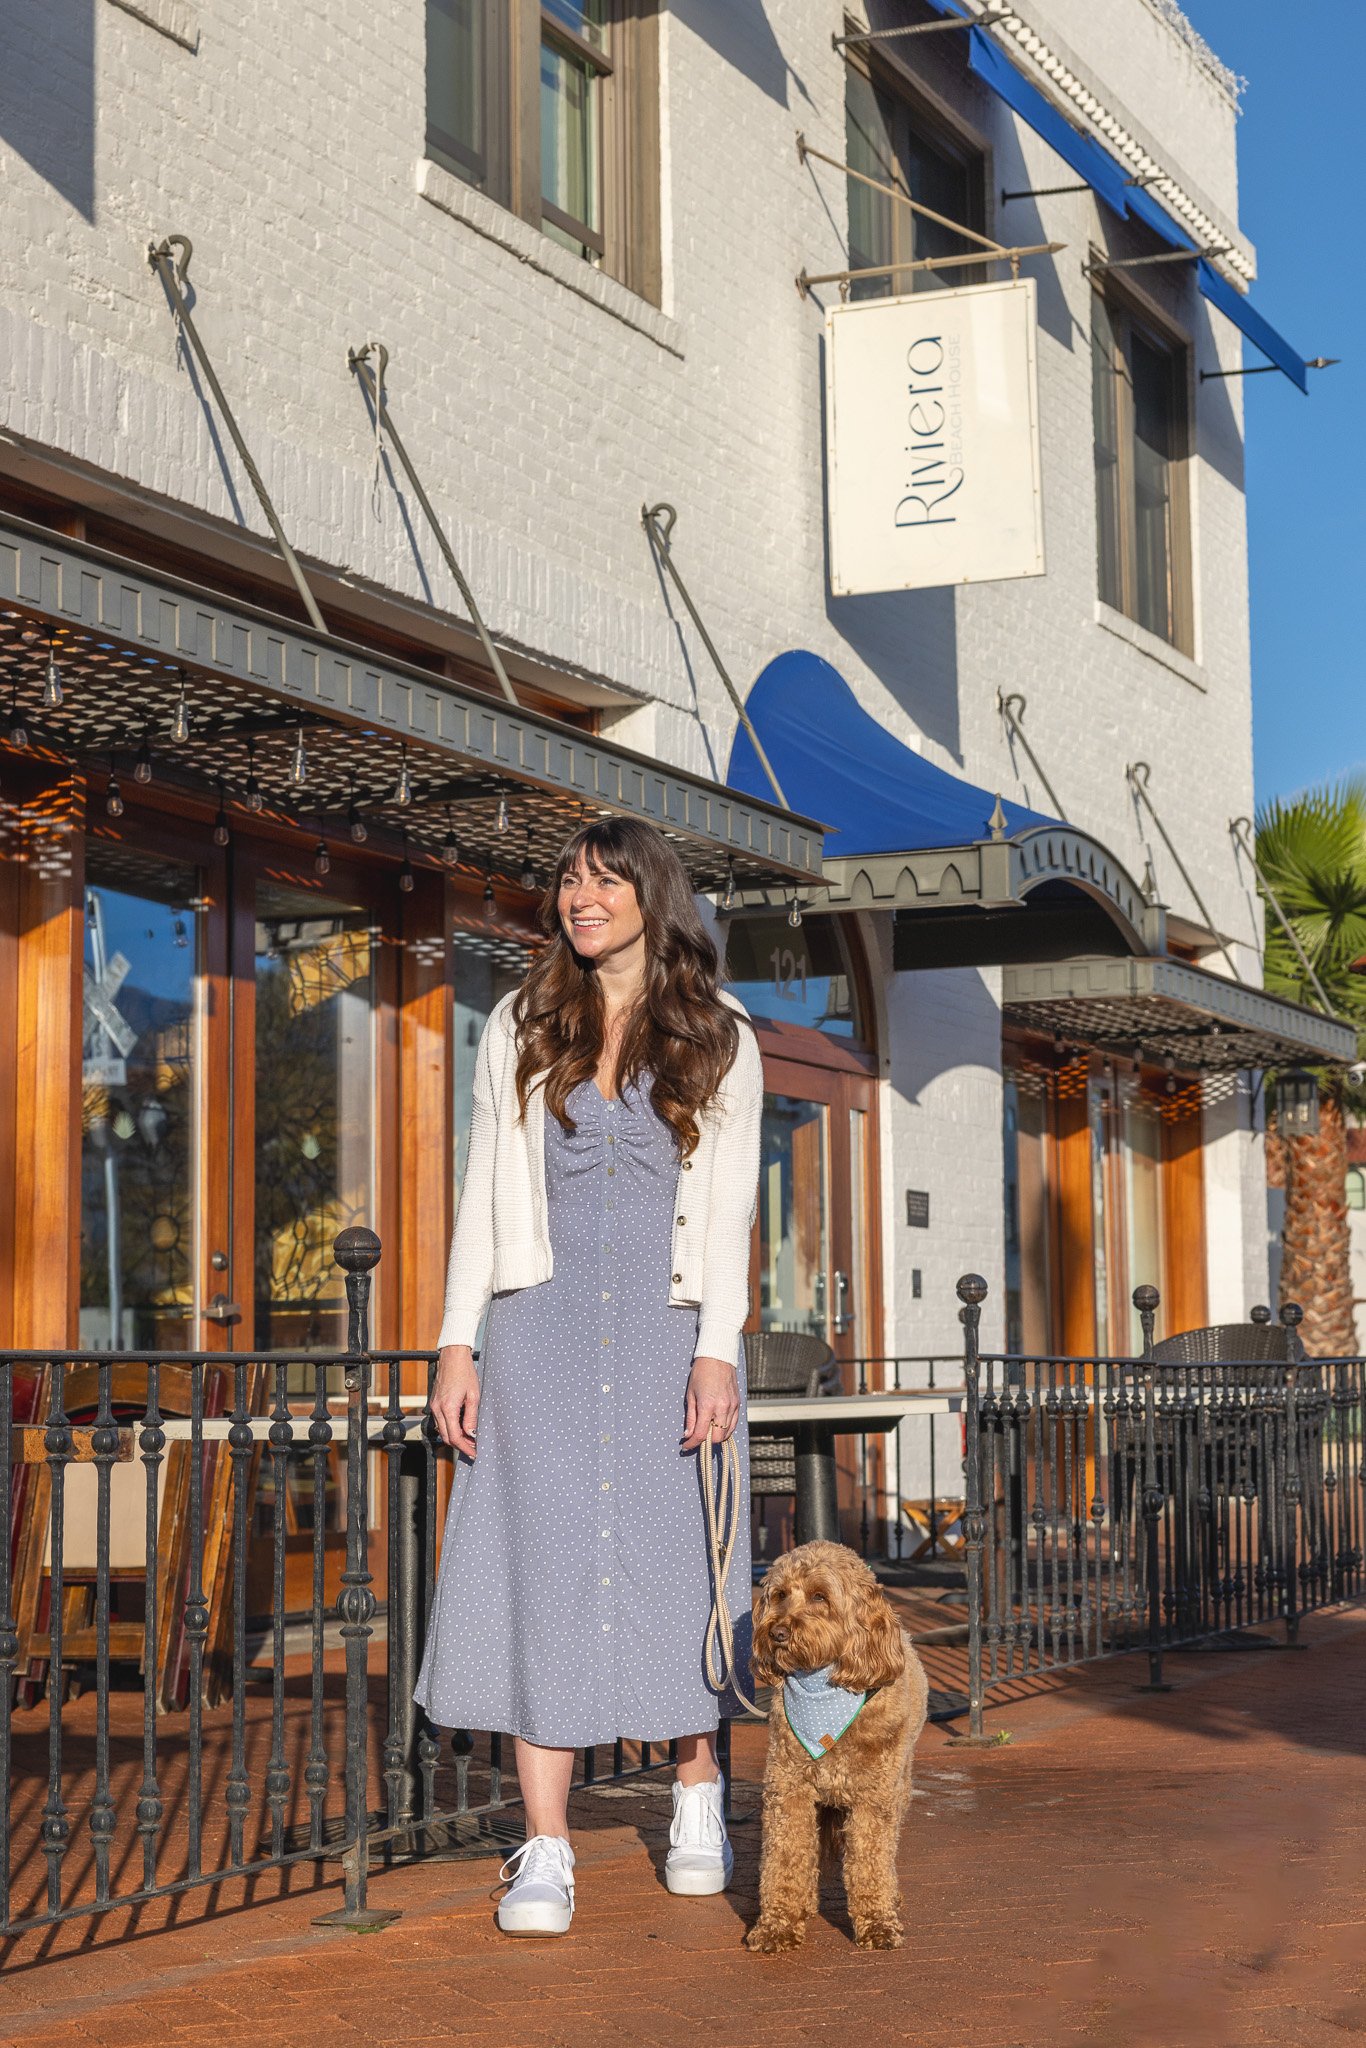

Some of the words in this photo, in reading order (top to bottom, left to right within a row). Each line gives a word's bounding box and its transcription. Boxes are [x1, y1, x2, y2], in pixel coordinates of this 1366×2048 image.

[948, 333, 961, 398] HOUSE
[894, 335, 964, 528] Riviera
[949, 402, 963, 466] BEACH
[769, 946, 807, 1004] 121
